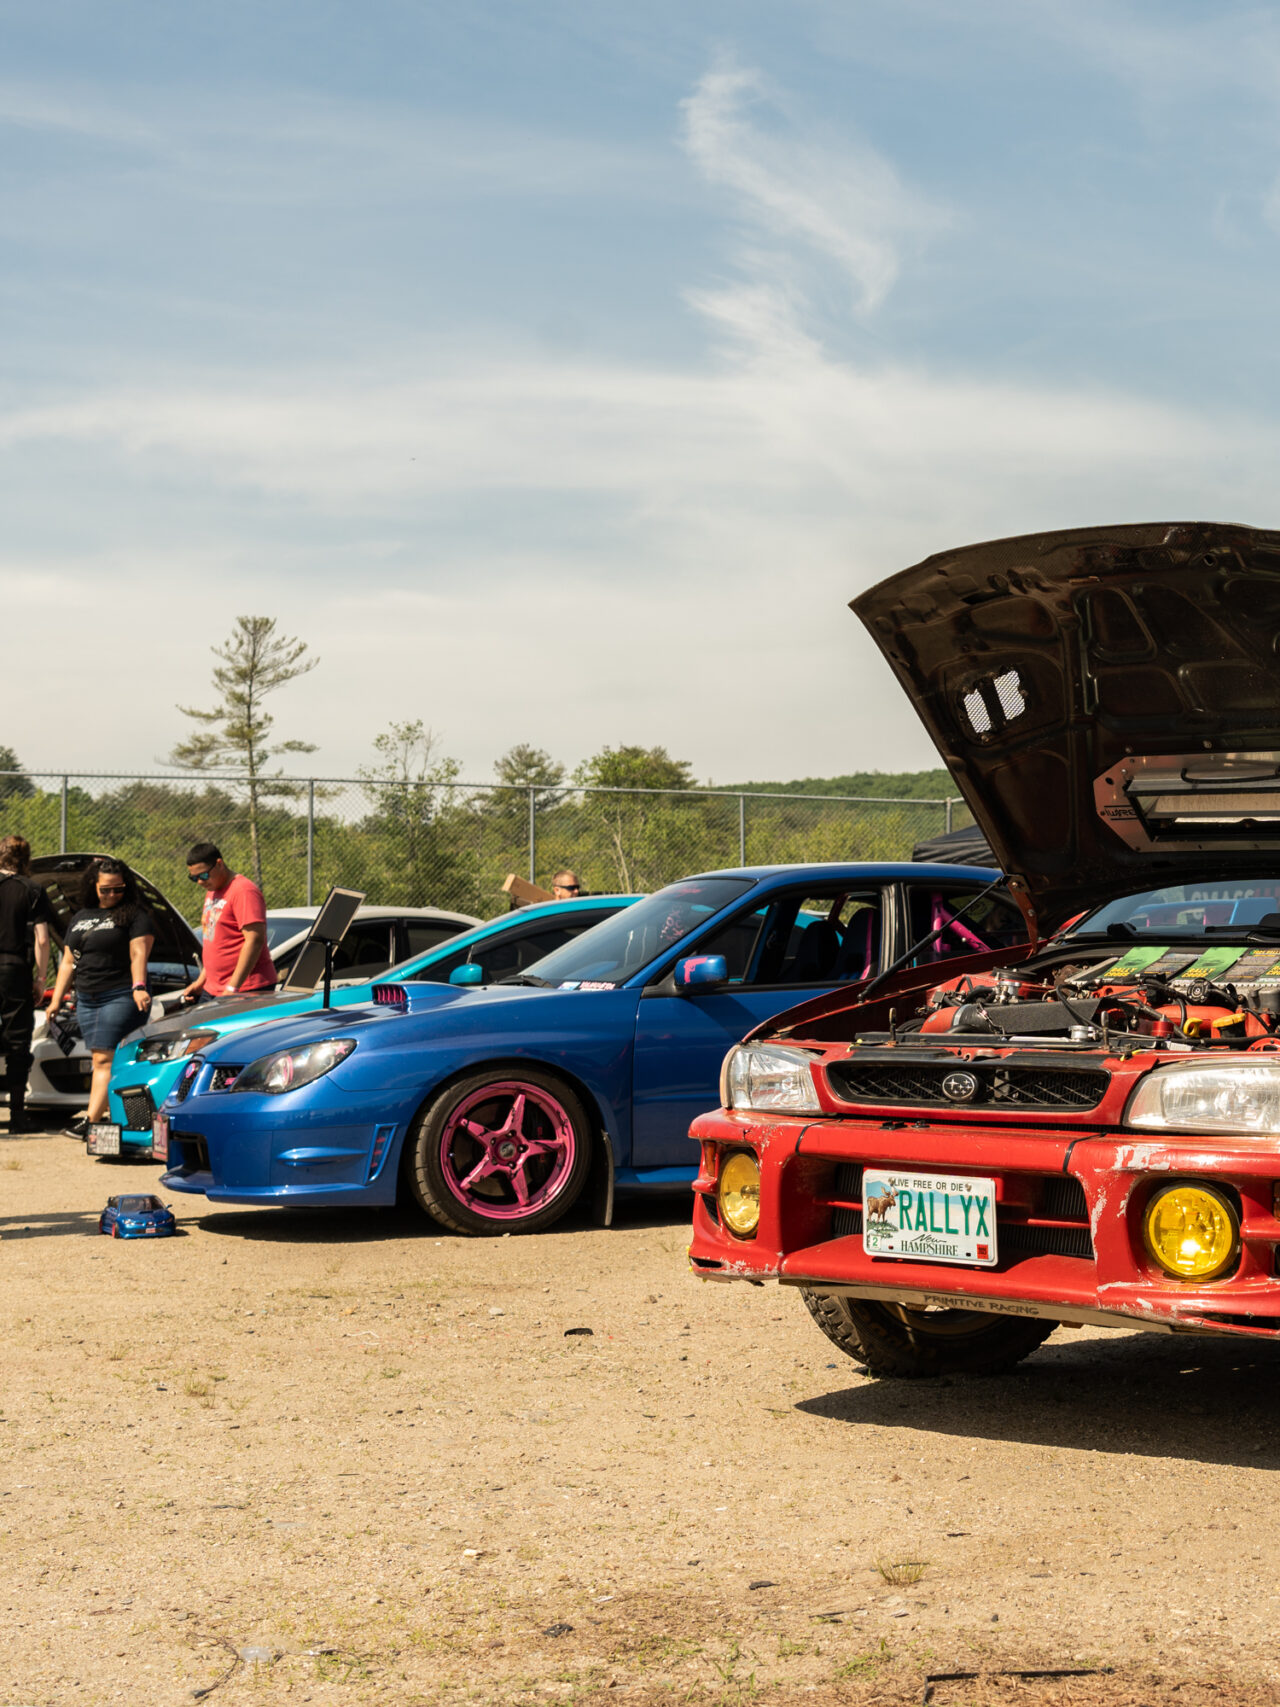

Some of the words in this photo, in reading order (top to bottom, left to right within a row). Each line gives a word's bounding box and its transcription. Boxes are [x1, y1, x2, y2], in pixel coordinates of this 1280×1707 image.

[894, 1178, 909, 1188] LIVE
[913, 1179, 932, 1189] FREE
[936, 1181, 946, 1190] OR
[950, 1182, 963, 1192] DIE
[899, 1190, 990, 1237] RALLYX
[872, 1236, 878, 1247] 2
[911, 1233, 947, 1243] New
[901, 1240, 958, 1257] HAMPSHIRE
[923, 1294, 985, 1308] PRIMITIVE
[989, 1302, 1040, 1316] RACING
